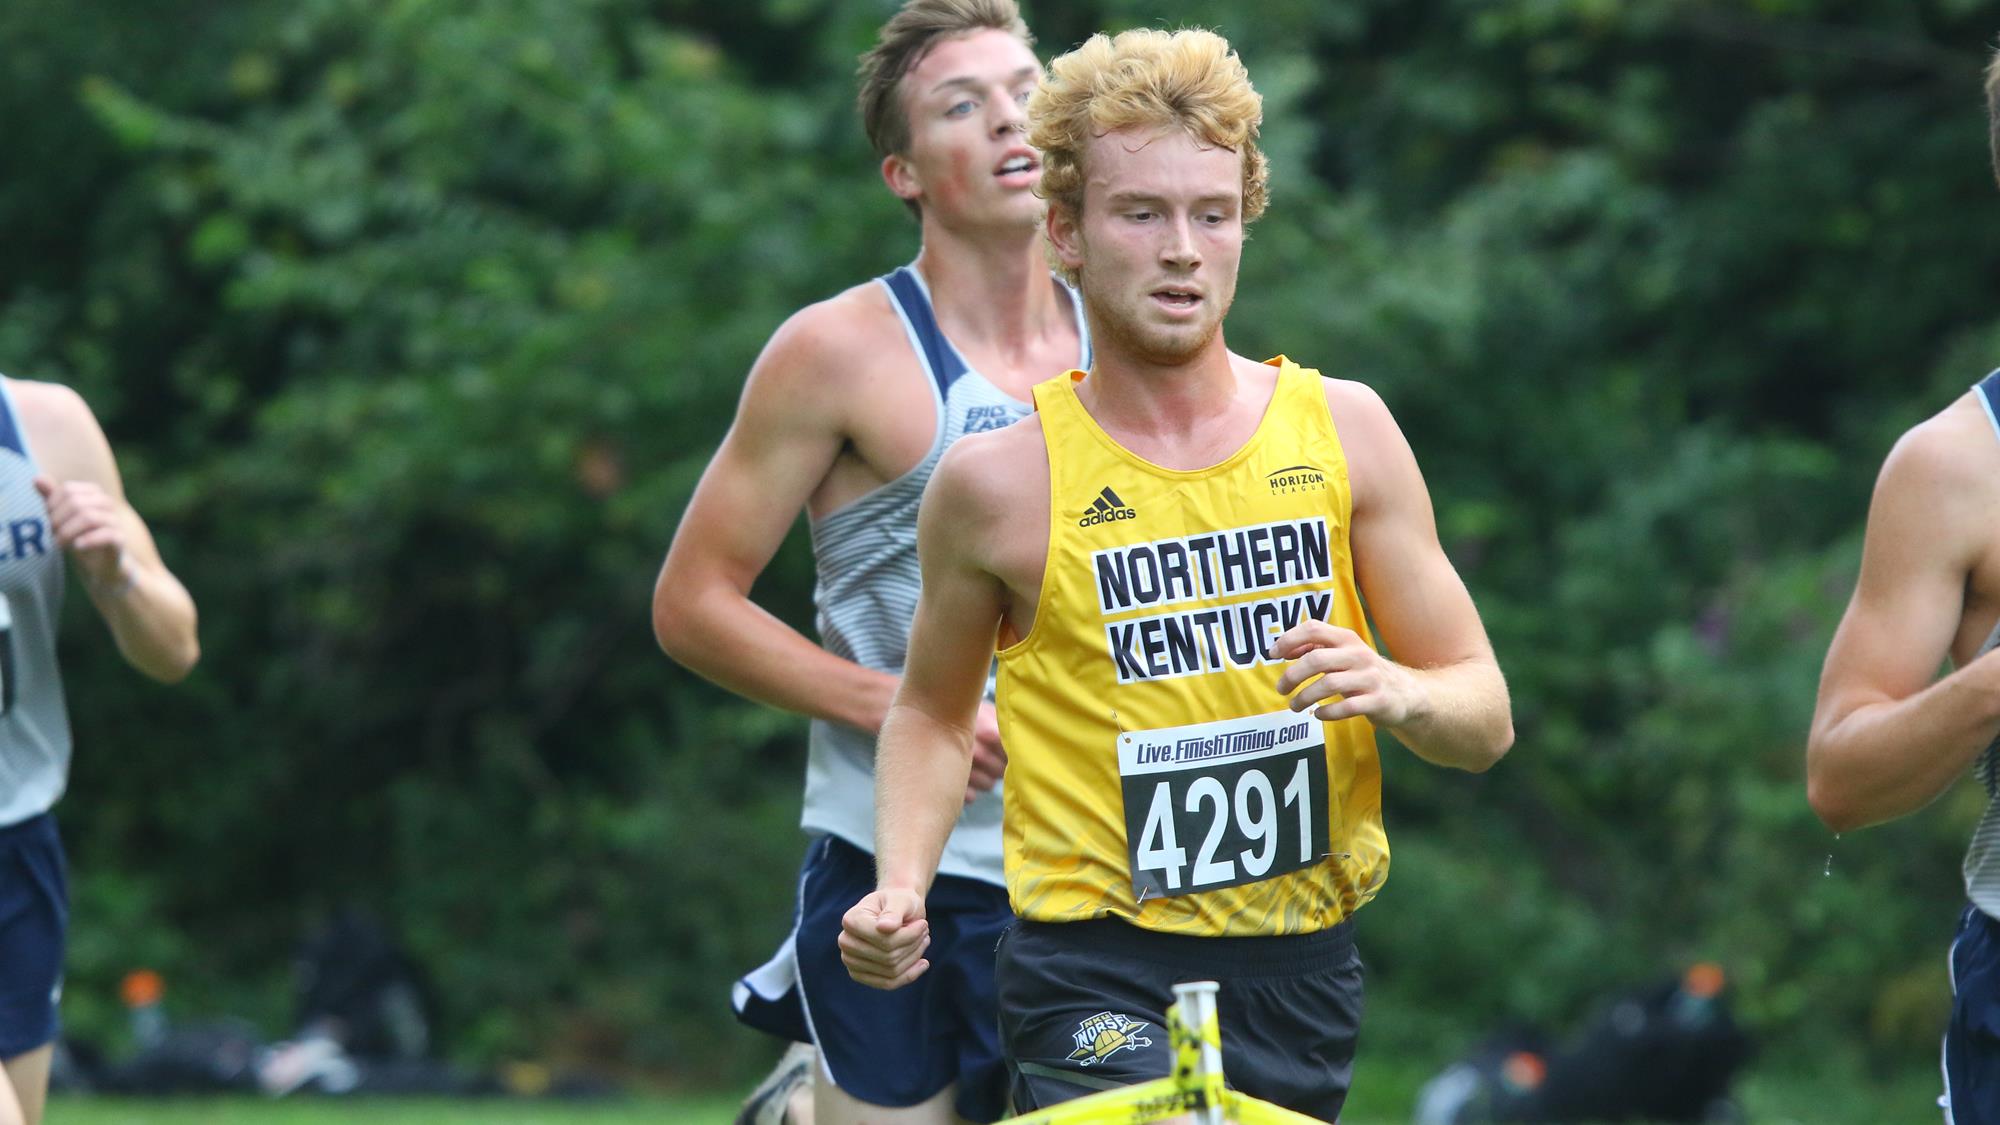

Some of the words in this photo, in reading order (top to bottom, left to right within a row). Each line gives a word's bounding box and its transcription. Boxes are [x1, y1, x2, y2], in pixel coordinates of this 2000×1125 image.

[1269, 473, 1324, 489] HORIZON
[1271, 483, 1327, 496] LEAGUE
[1079, 506, 1137, 528] adidas
[1094, 518, 1332, 612] NORTHERN
[1136, 721, 1309, 765] Live.FinishTiming.com
[1137, 757, 1313, 890] 4291
[1077, 1015, 1129, 1048] NORSE
[1084, 1013, 1110, 1029] NKU
